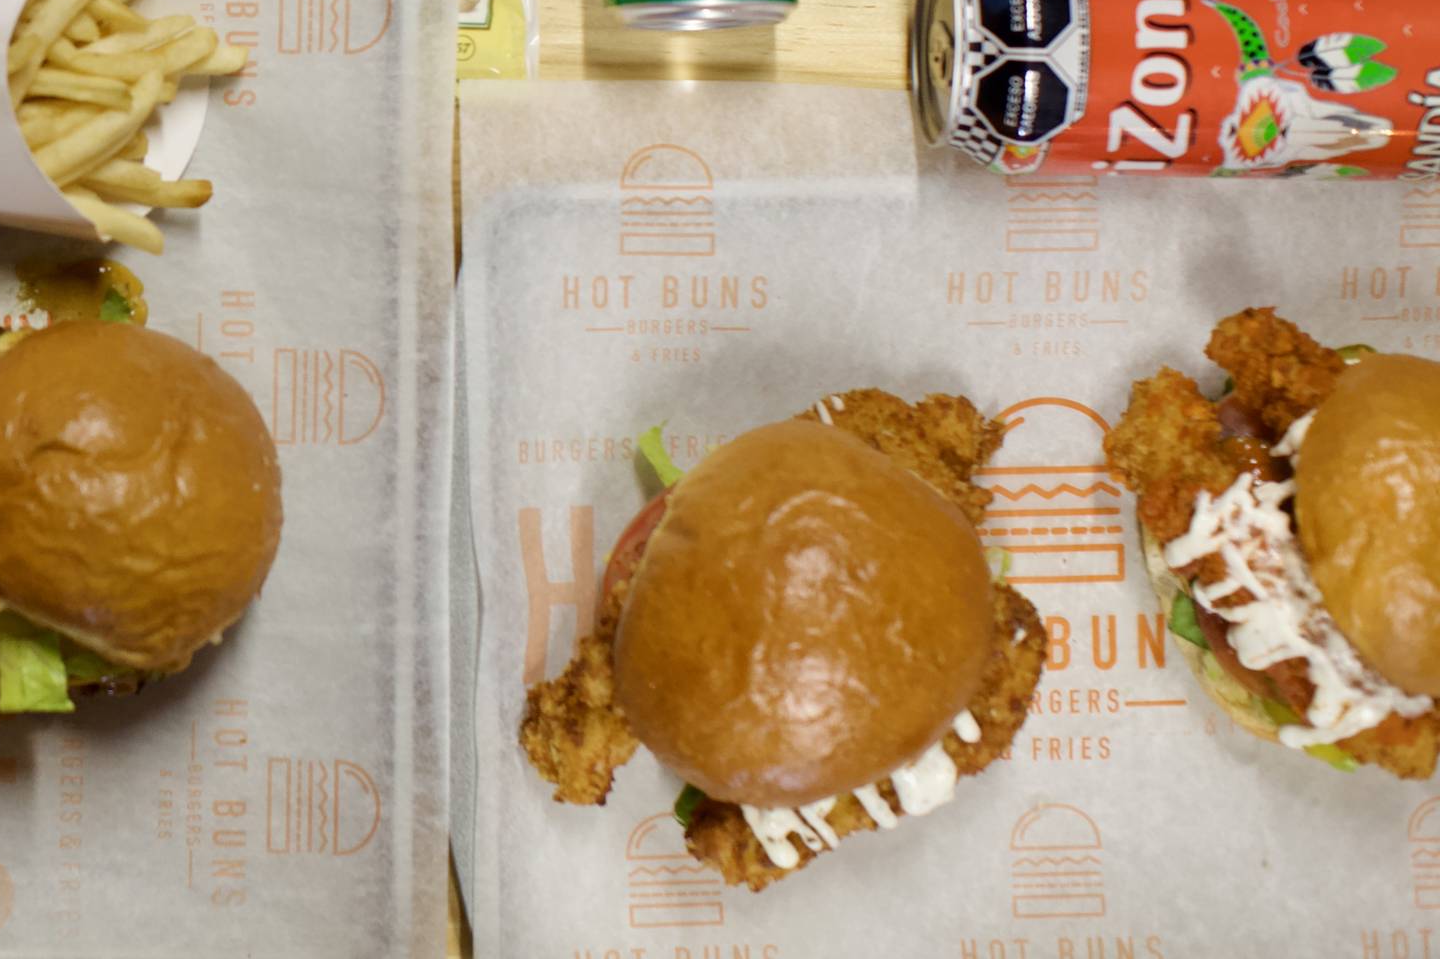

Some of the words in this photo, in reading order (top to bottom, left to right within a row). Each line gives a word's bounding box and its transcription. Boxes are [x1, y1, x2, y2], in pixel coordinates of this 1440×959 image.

[1004, 75, 1023, 128] EXCESO
[560, 274, 636, 310] HOT
[662, 274, 769, 310] BUNS
[946, 271, 1020, 305] HOT
[1045, 270, 1150, 305] BUNS
[1342, 266, 1413, 301] HOT
[220, 289, 256, 364] HOT
[626, 319, 710, 336] BURGERS
[517, 434, 635, 465] BURGERS
[1044, 612, 1167, 672] BUN
[1029, 687, 1121, 715] RGERS
[213, 698, 249, 772] HOT
[1031, 736, 1112, 761] FRIES
[210, 799, 249, 909] BUNS
[1359, 927, 1433, 959] HOT
